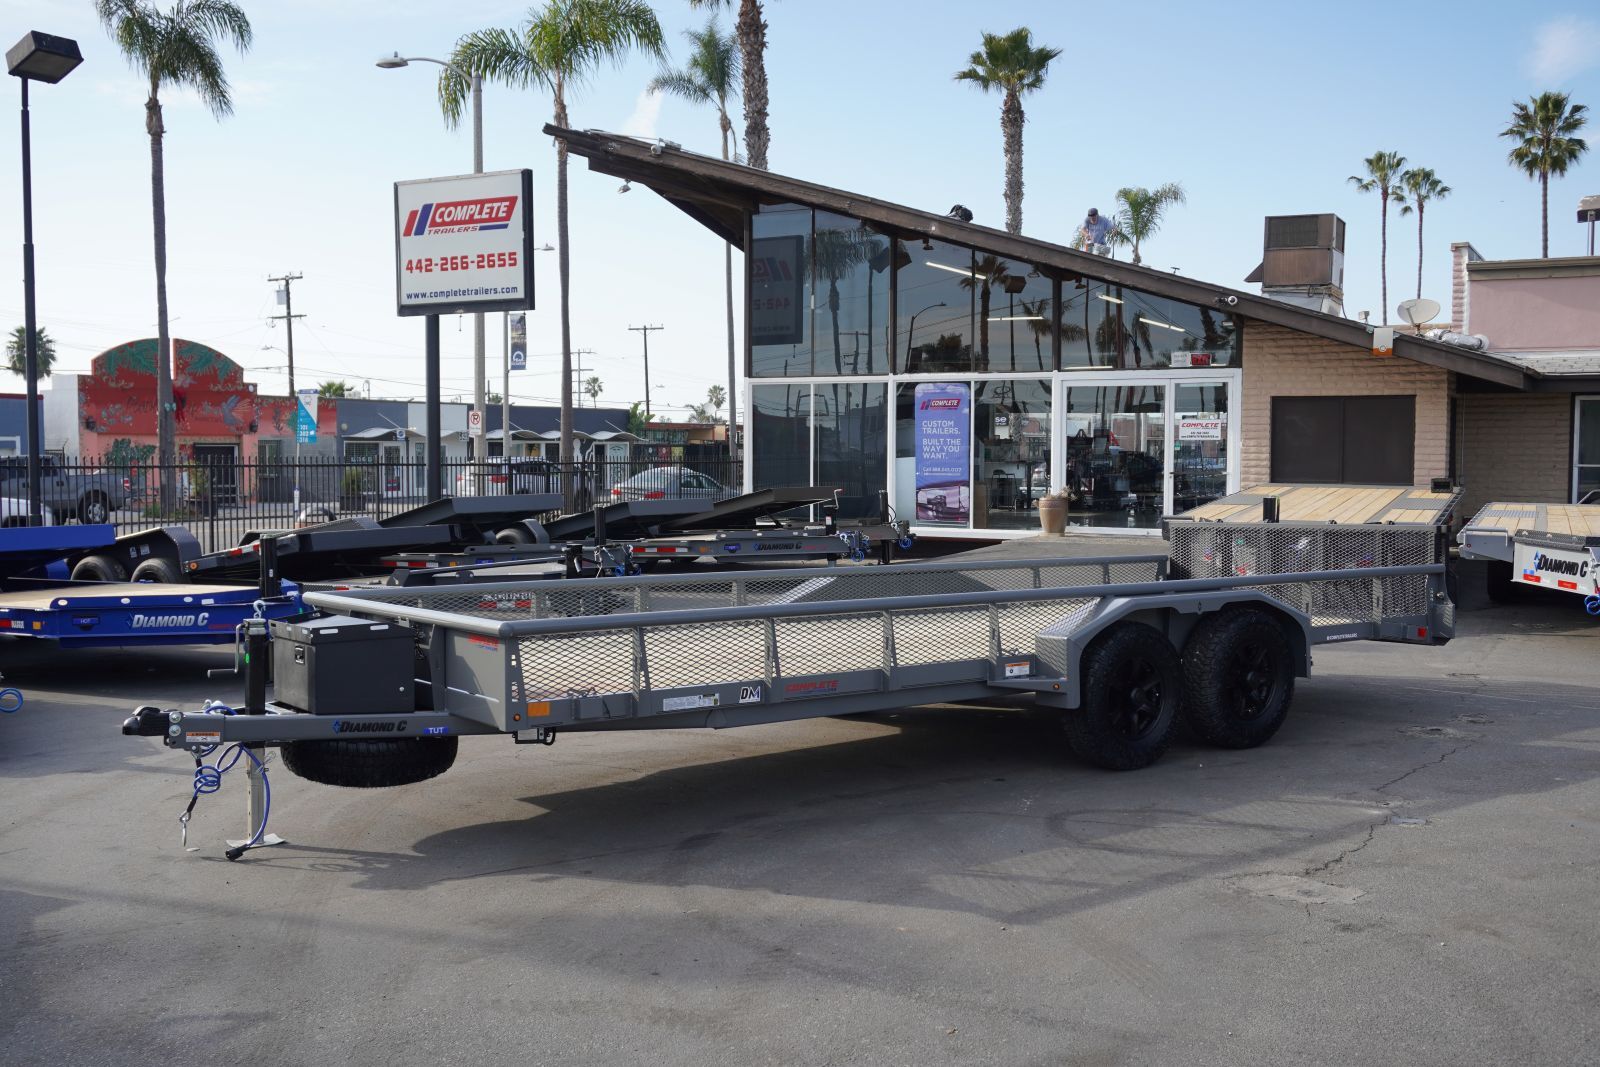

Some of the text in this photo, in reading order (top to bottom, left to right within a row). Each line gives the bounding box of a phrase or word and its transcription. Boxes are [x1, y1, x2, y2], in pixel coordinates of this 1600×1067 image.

[435, 202, 509, 222] COMPLETE
[428, 225, 478, 235] TRAILERS
[406, 252, 517, 273] 442-266-2655
[406, 286, 518, 300] www.completetrailers.com
[922, 427, 961, 435] TRAILERS.
[922, 438, 961, 446] BUILT THE
[922, 445, 960, 453] WAY YOU
[922, 452, 948, 460] WANT.
[1579, 560, 1589, 578] C
[197, 612, 210, 626] C
[740, 686, 761, 700] DM
[396, 720, 408, 732] C
